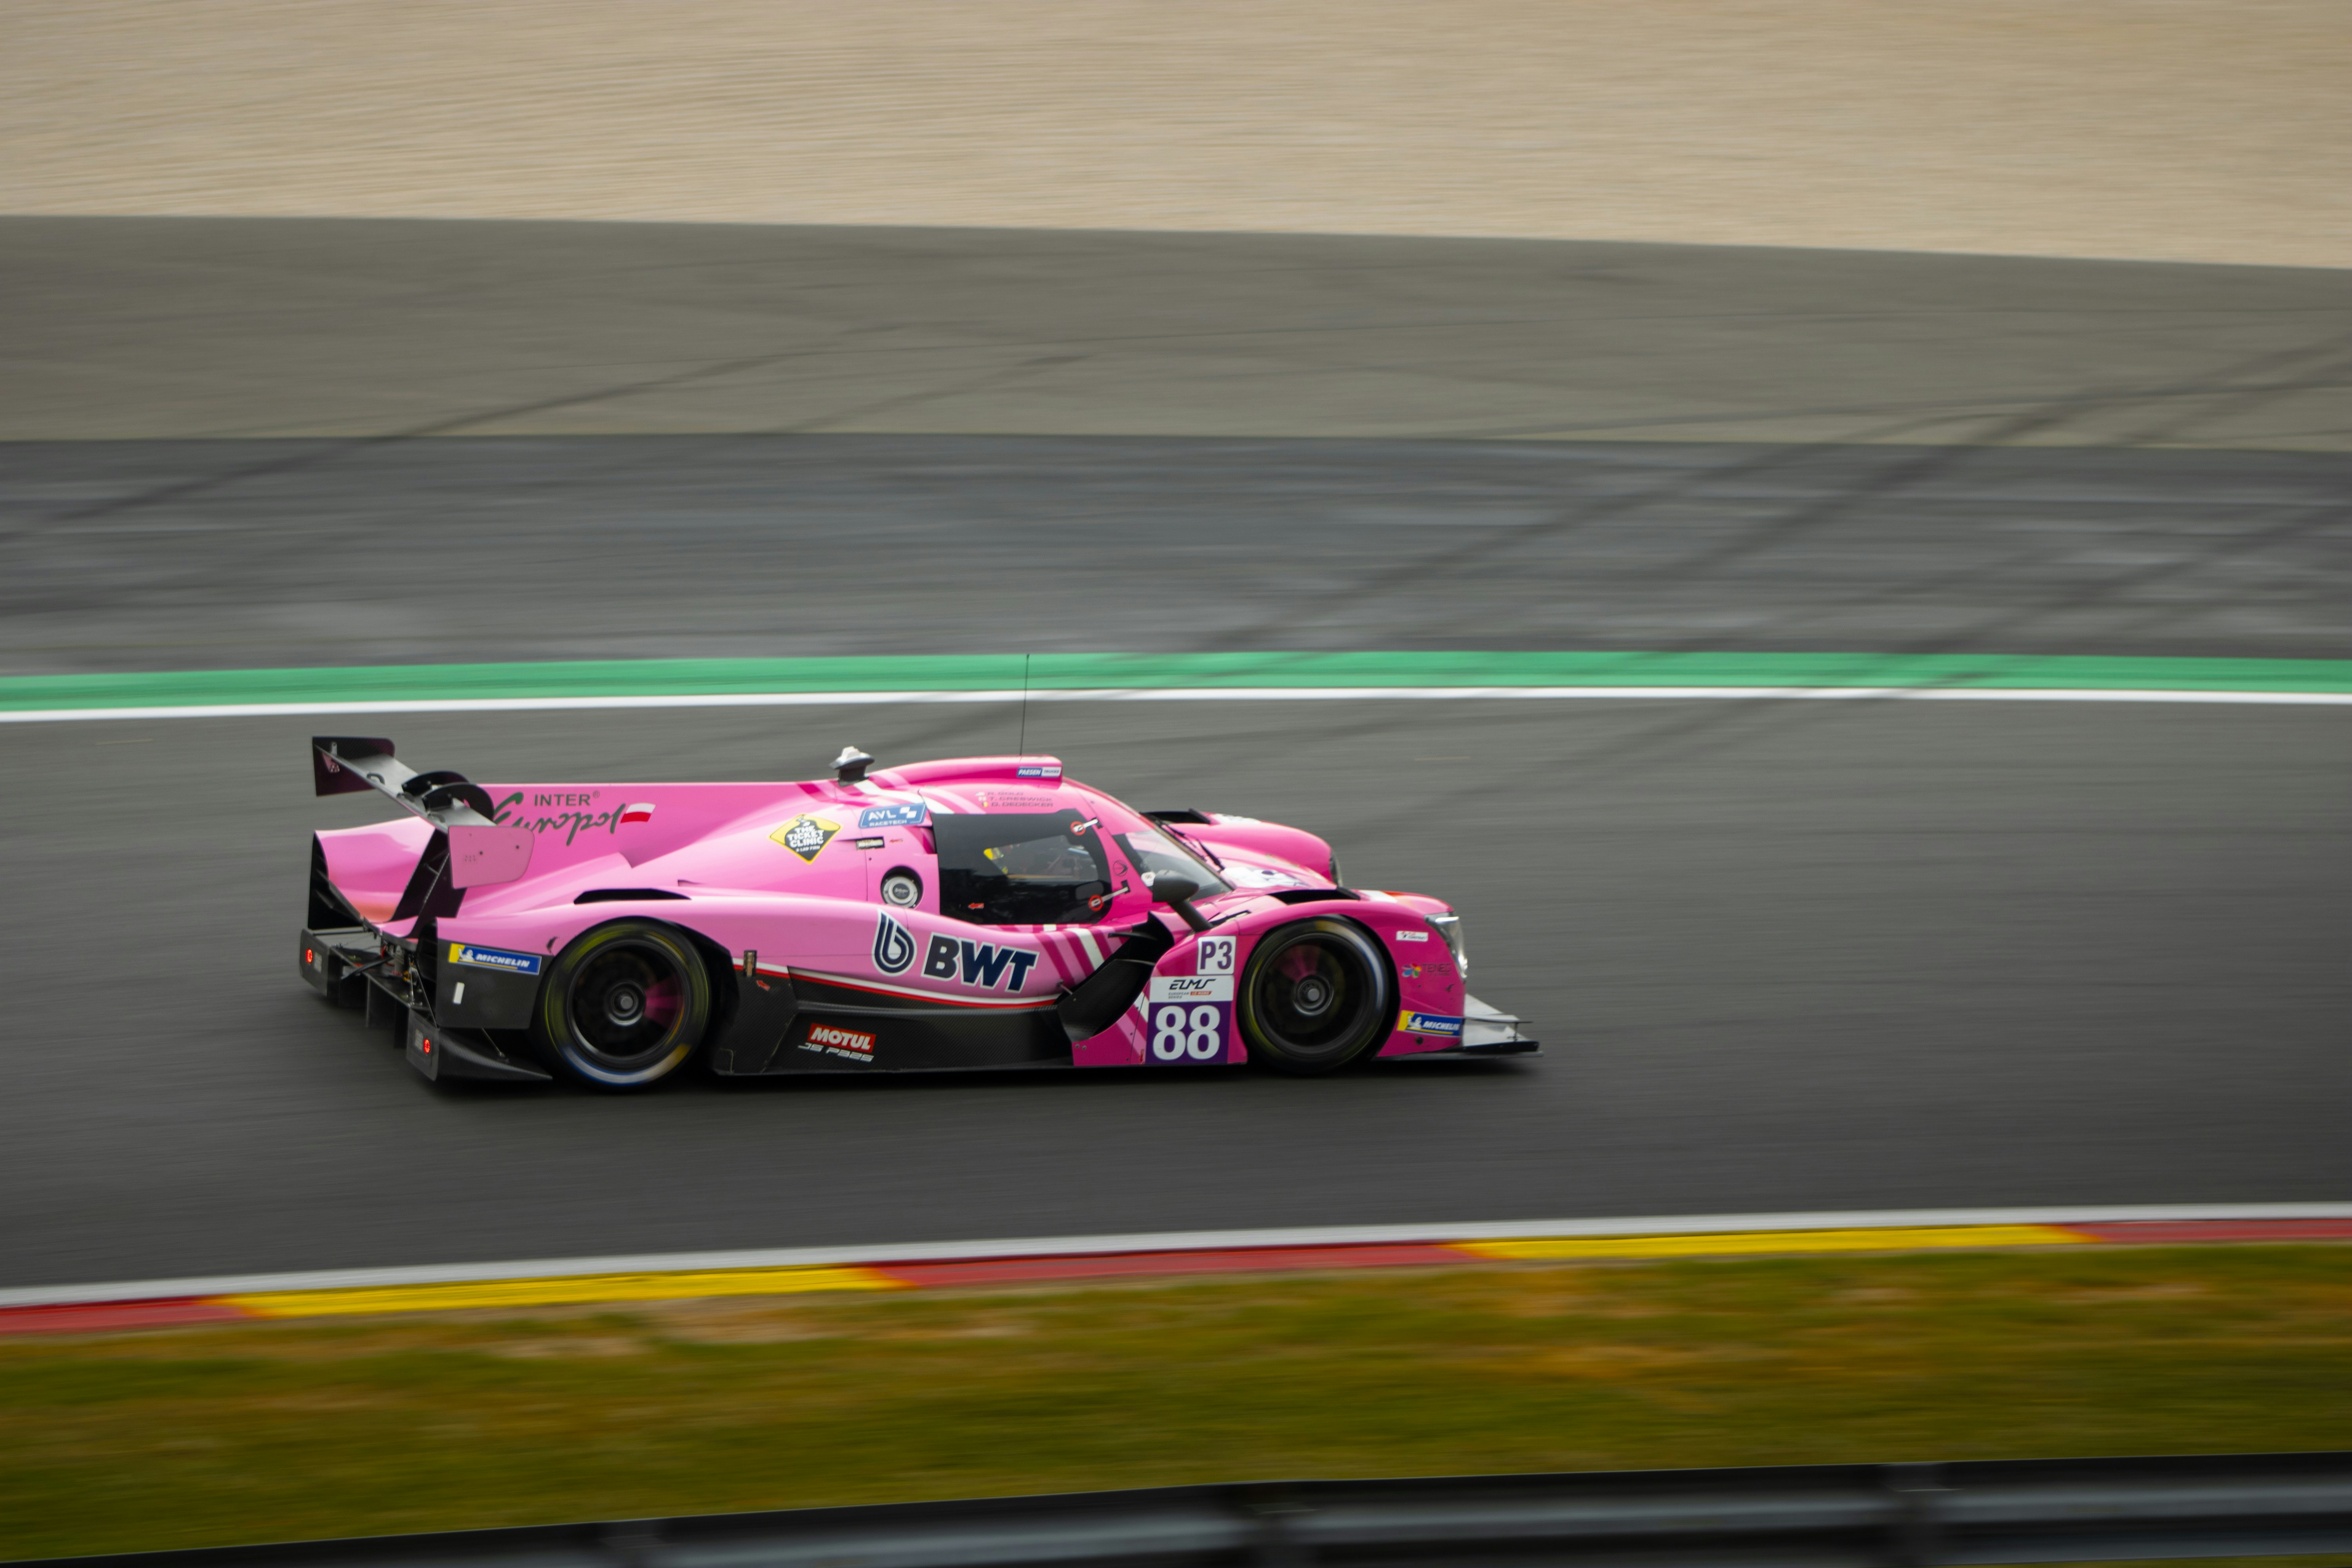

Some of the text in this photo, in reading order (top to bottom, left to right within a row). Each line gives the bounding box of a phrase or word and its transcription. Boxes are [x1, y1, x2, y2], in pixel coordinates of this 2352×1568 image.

[534, 794, 591, 806] INTER
[868, 810, 897, 821] AVL
[787, 830, 824, 841] TICKET
[789, 836, 824, 848] CLINIC
[476, 954, 530, 967] MICHELIN
[1200, 941, 1232, 969] P3
[920, 932, 1040, 994] BWT
[1169, 978, 1217, 990] ELMS
[1422, 1020, 1461, 1031] MICHELIN
[811, 1027, 871, 1050] MOTUL
[1152, 1005, 1220, 1060] 88
[798, 1042, 824, 1052] JS
